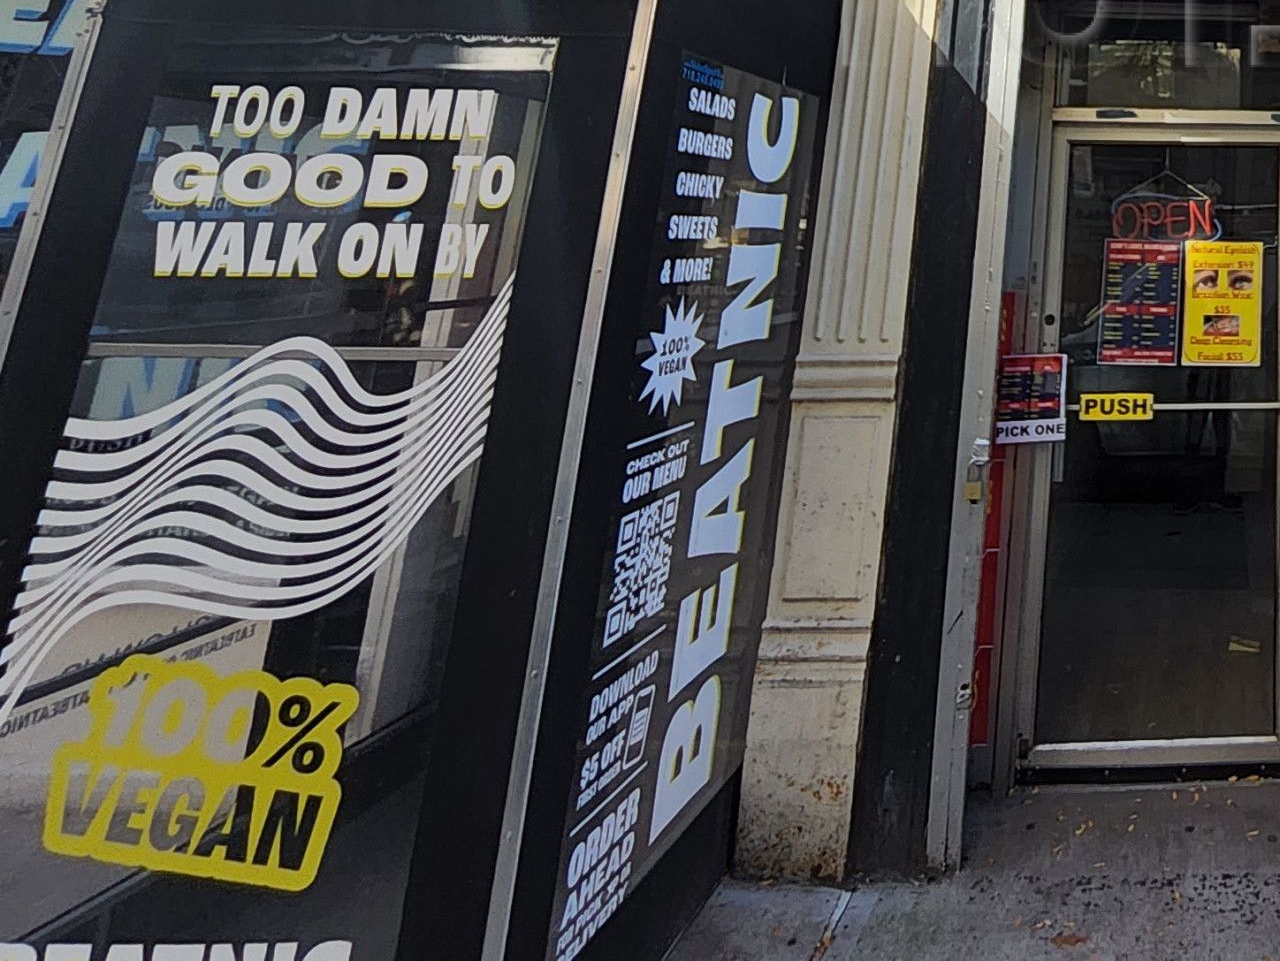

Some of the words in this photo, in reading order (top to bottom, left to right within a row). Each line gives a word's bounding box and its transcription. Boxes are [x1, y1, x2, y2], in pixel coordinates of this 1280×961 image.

[210, 84, 305, 138] TOO
[320, 86, 499, 141] DAMN
[688, 86, 737, 121] SALADS
[677, 127, 734, 160] BURGERS
[151, 151, 429, 208] GOOD
[451, 155, 516, 209] TO
[675, 171, 724, 201] CHICKY
[668, 214, 719, 241] SWEETS
[1111, 198, 1213, 239] OPEN
[154, 221, 327, 278] WALK
[337, 222, 425, 278] ON
[433, 223, 490, 279] BY
[660, 258, 671, 285] &
[672, 256, 714, 284] MORE!
[659, 357, 688, 376] VEGAN
[660, 336, 691, 357] 100%
[996, 425, 1030, 439] PICK
[1034, 423, 1065, 436] ONE
[1083, 398, 1148, 416] PUSH
[622, 471, 652, 504] OUR
[652, 455, 687, 491] MENU
[626, 448, 666, 475] CHECK
[667, 439, 691, 459] OUT
[649, 93, 800, 847] BEATNIC
[589, 649, 660, 723] DOWNLOAD
[103, 674, 342, 774] 100%
[586, 715, 607, 746] OUR
[608, 694, 635, 729] APP
[580, 751, 600, 791] $5
[601, 728, 627, 770] OFF
[59, 761, 323, 871] VEGAN
[567, 788, 641, 889] ORDER
[560, 830, 636, 932] AHEAD
